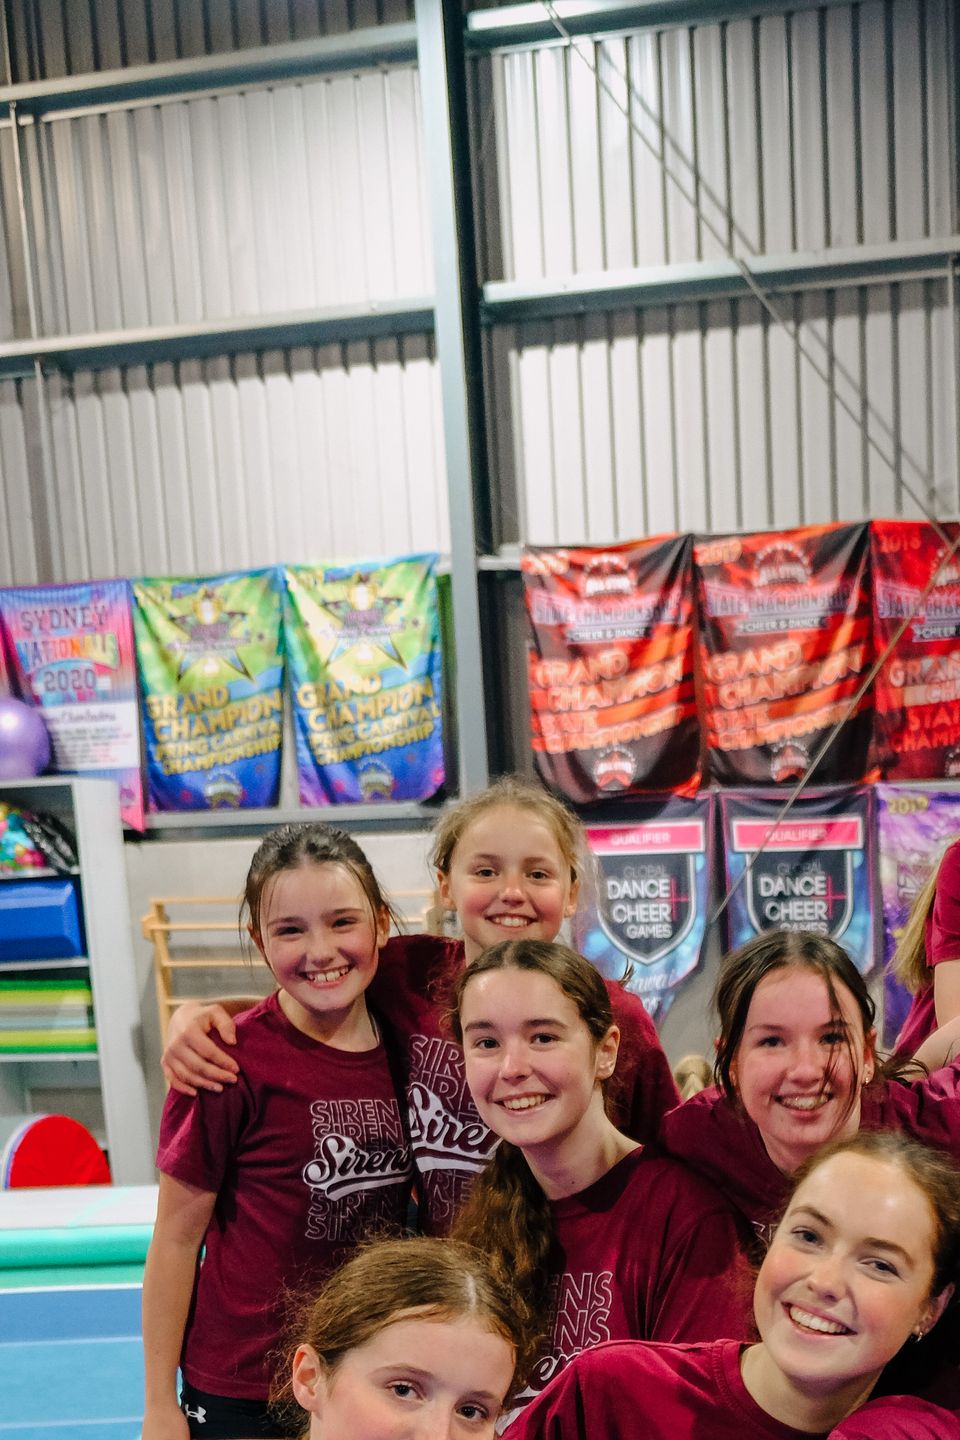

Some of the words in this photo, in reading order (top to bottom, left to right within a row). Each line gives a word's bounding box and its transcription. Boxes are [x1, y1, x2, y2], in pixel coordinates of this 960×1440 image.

[20, 604, 108, 632] SYDNEY
[705, 639, 802, 685] GRAND
[43, 668, 97, 692] 2020
[155, 688, 282, 741] CHAMPION
[308, 677, 433, 731] CHAMPION
[611, 830, 672, 846] QUALIFIER
[606, 878, 671, 900] DANCE
[759, 875, 828, 897] DANCE
[612, 903, 673, 924] CHEER
[764, 899, 828, 921] CHEER
[626, 923, 673, 940] GAMES
[309, 1098, 400, 1126] SIREN
[313, 1122, 403, 1152] SIREN
